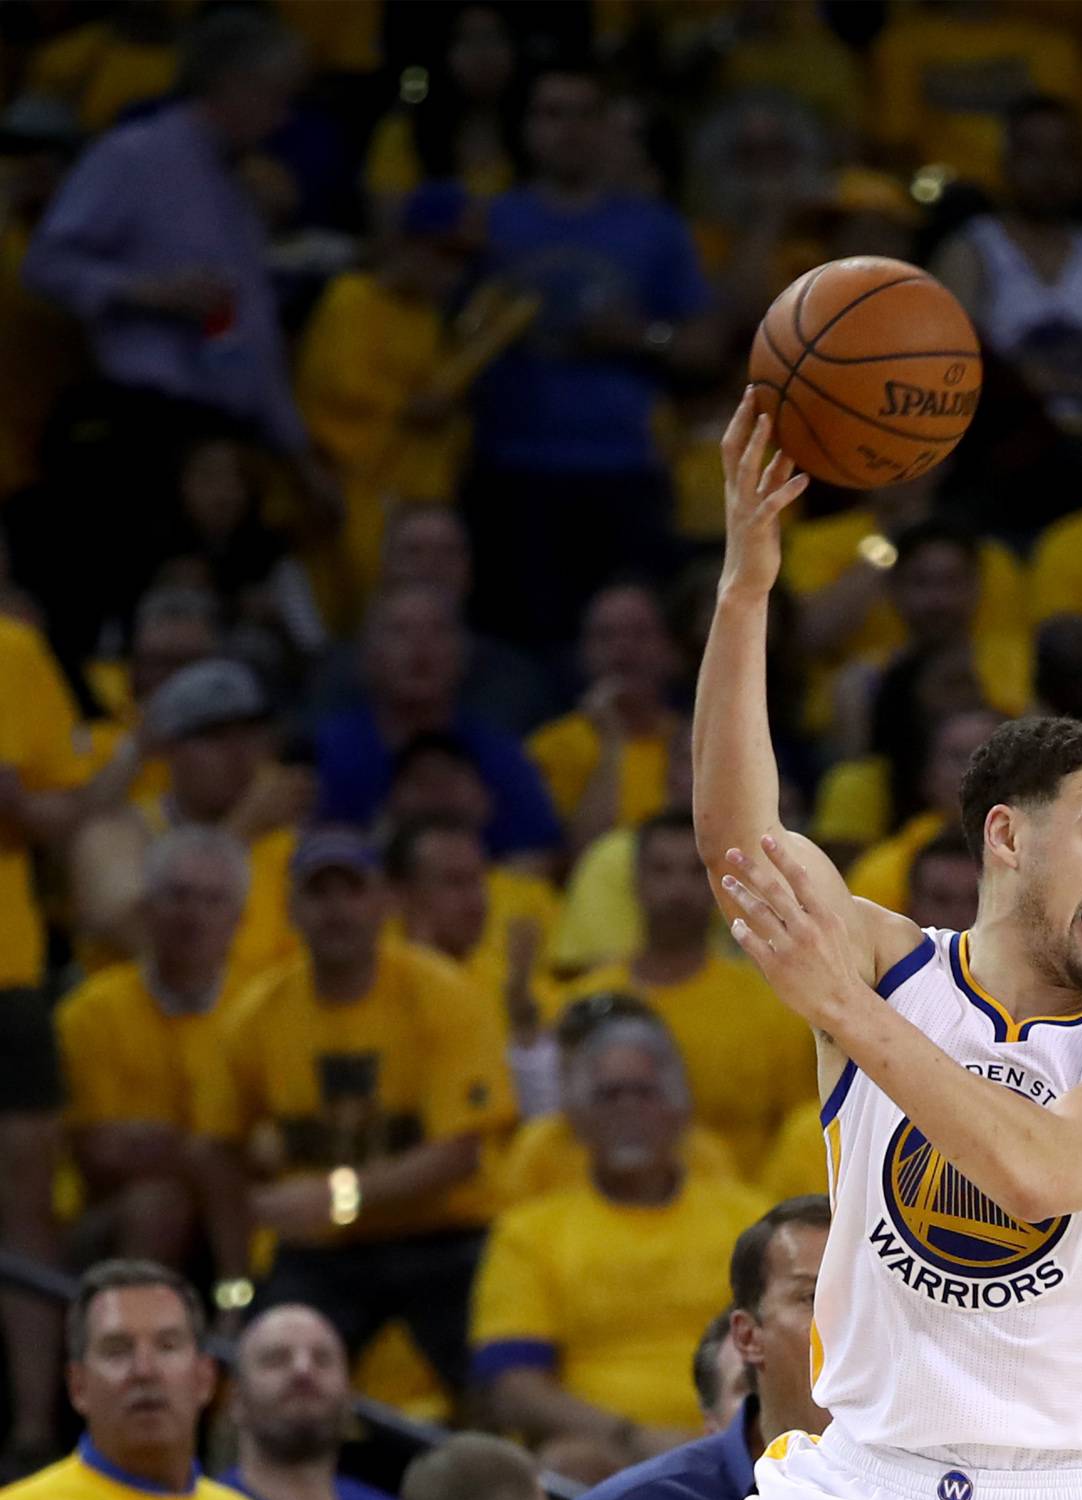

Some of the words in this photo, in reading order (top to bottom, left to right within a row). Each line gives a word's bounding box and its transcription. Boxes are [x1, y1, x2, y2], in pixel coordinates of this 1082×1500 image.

[965, 1065, 1025, 1087] DEN
[869, 1217, 1064, 1309] WARRIORS
[943, 1479, 969, 1500] W
